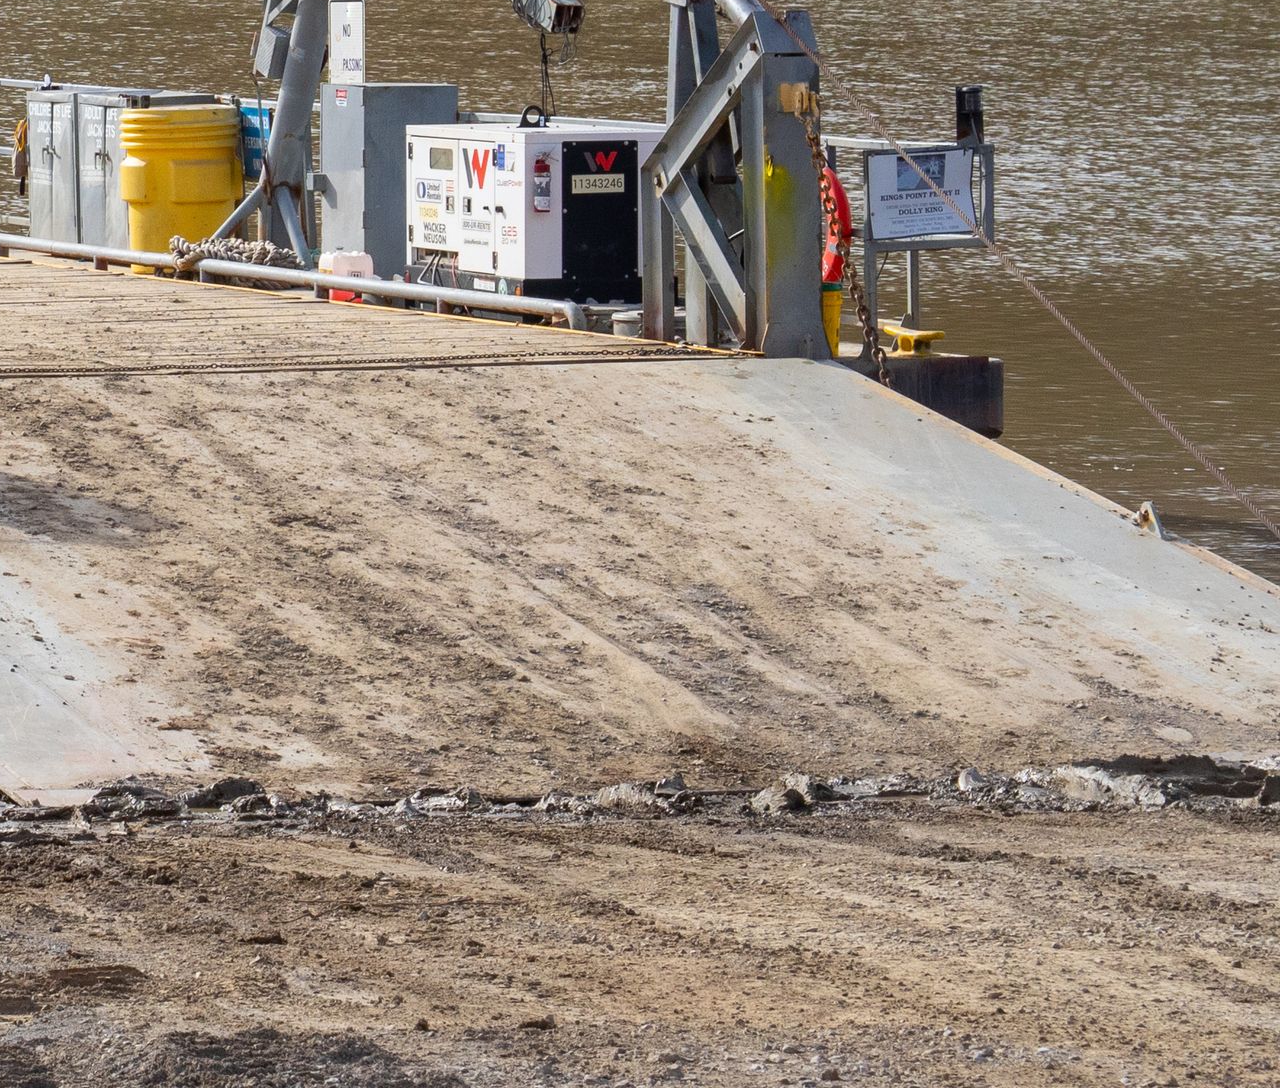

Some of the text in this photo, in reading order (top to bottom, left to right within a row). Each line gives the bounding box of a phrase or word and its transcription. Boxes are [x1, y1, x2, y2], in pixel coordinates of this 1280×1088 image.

[342, 23, 351, 37] NO
[343, 58, 363, 72] PASSING
[61, 105, 72, 118] LIFE
[84, 106, 118, 121] ADULT LIFE
[87, 124, 116, 138] JACKETS
[426, 183, 441, 192] United
[573, 177, 623, 189] 11343246
[426, 191, 442, 200] Rentals
[880, 193, 904, 202] KINGS
[905, 191, 926, 200] POINT
[929, 189, 953, 198] FERY
[898, 206, 944, 216] DOLLY KING
[423, 221, 447, 233] WACKER
[423, 233, 447, 245] NEUSON
